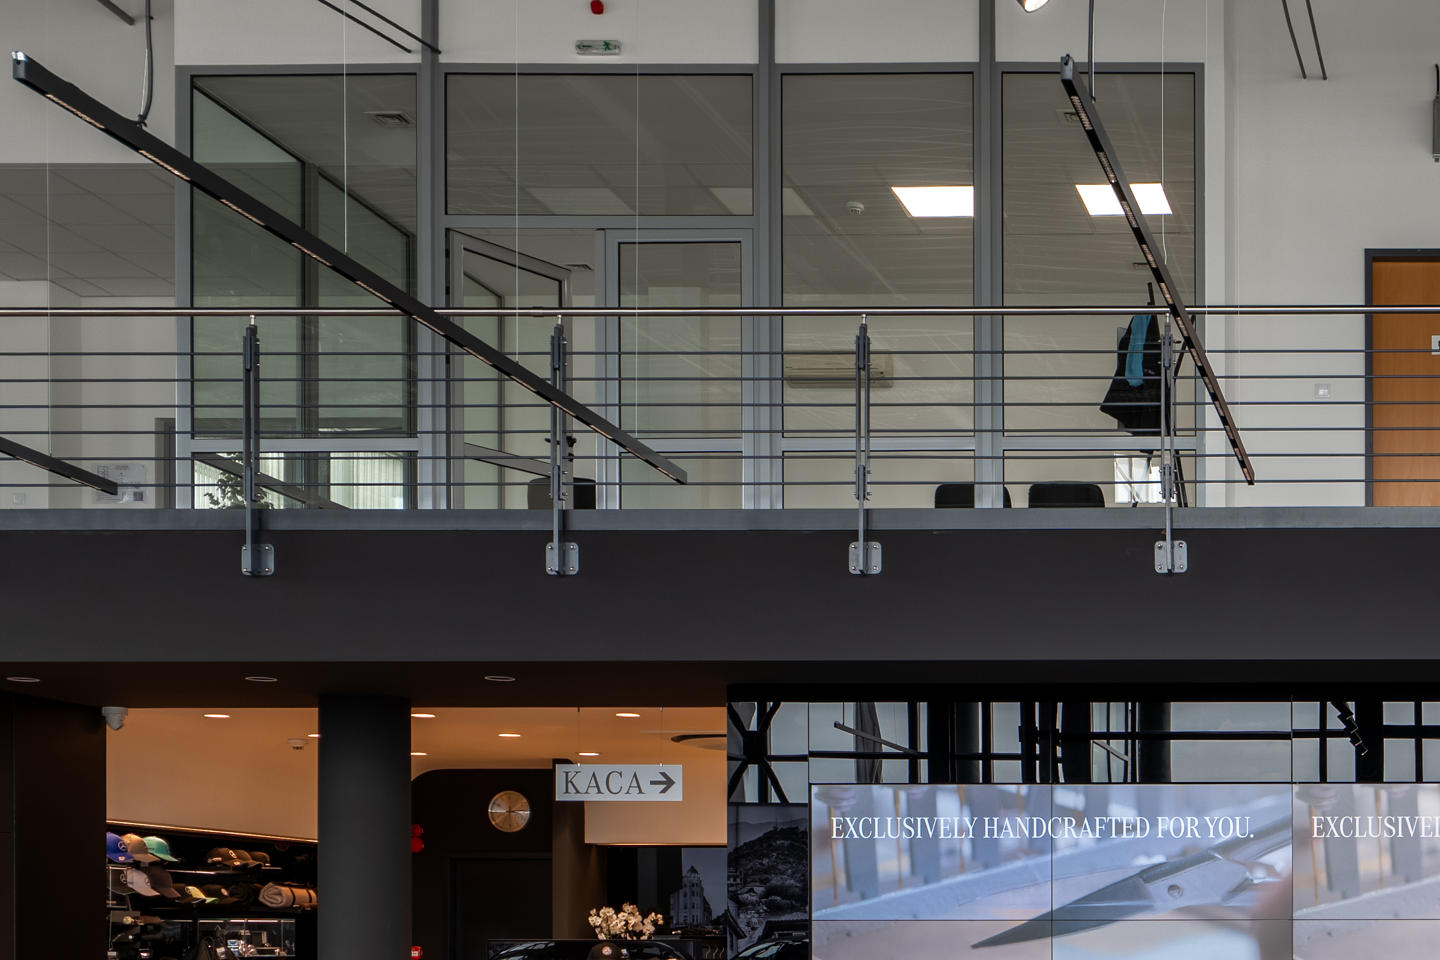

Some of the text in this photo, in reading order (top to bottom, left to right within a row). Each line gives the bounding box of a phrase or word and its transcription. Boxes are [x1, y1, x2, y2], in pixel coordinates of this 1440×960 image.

[562, 770, 646, 795] КАСА
[831, 816, 1254, 839] EXCLUSIVELY HANDCRAFTED FOR YOU.
